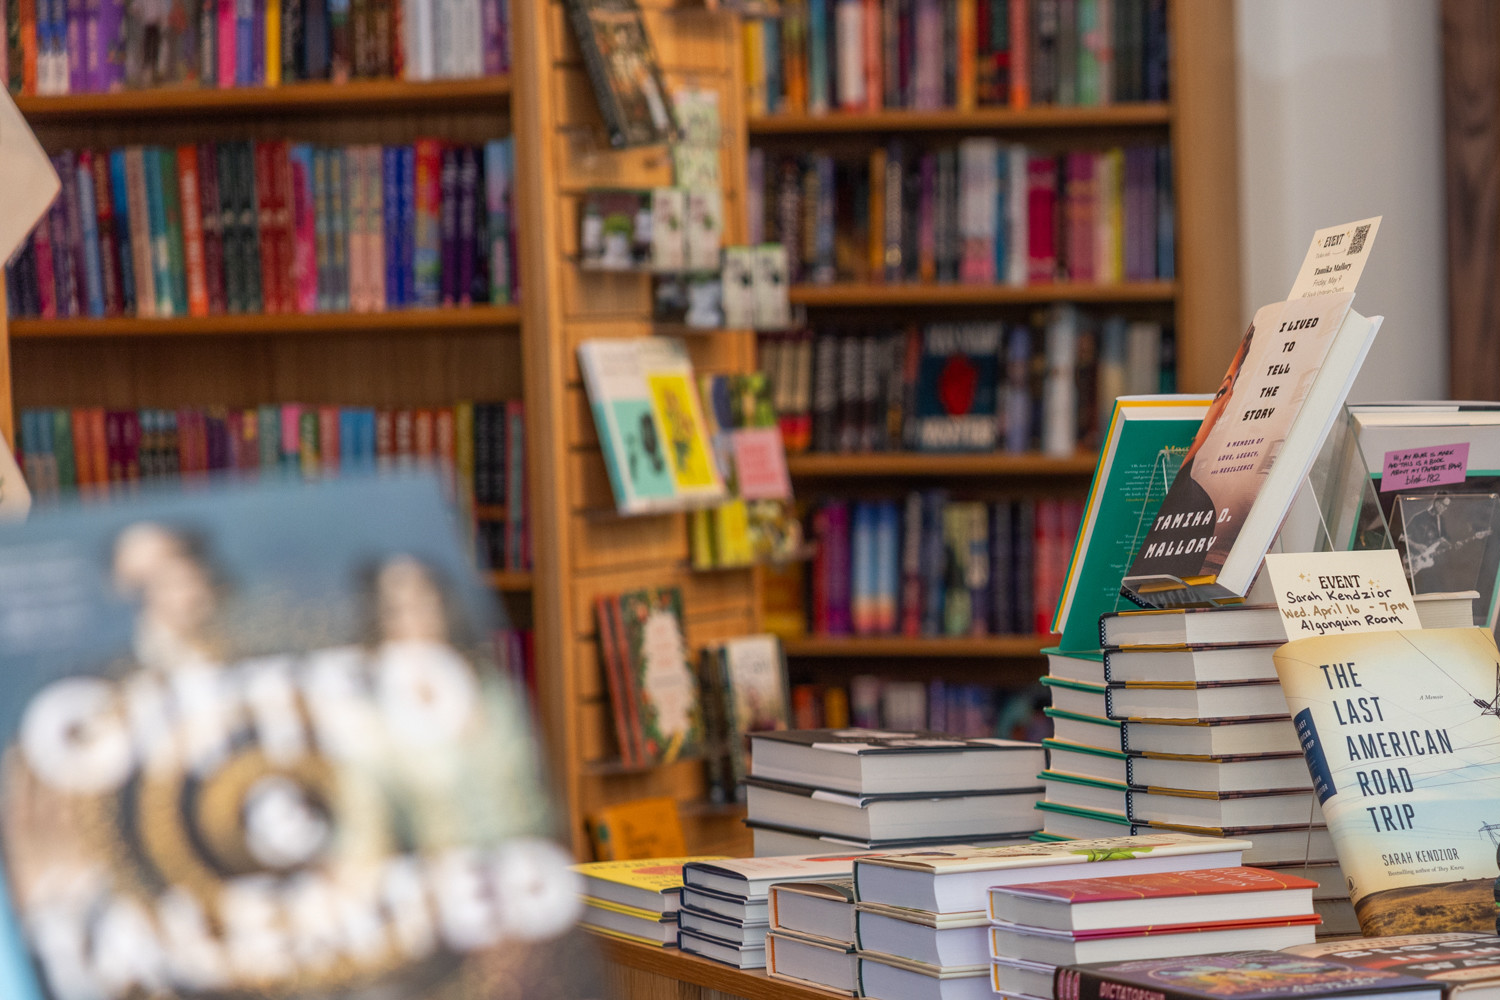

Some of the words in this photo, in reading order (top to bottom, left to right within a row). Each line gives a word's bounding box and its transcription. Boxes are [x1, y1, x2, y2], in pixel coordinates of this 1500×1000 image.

[1324, 233, 1345, 248] EVENT
[1314, 265, 1332, 275] Tamika
[1334, 262, 1352, 271] Mallory
[1279, 322, 1287, 332] I
[1289, 318, 1319, 330] LIVED
[1282, 341, 1295, 353] TO
[1267, 364, 1291, 376] TELL
[1260, 386, 1279, 398] THE
[1242, 408, 1275, 421] STORY
[1154, 508, 1215, 531] TAMIKA
[1217, 508, 1232, 524] D.
[1144, 536, 1217, 559] MALLORY
[1318, 575, 1360, 589] EVENT
[1287, 591, 1322, 603] Sarah
[1326, 588, 1391, 601] Kendzior
[1282, 608, 1310, 619] Wed.
[1313, 603, 1342, 619] April
[1346, 604, 1360, 615] 16
[1379, 602, 1409, 614] 7pm
[1301, 617, 1361, 634] Algonquin
[1365, 615, 1403, 625] Room
[1320, 662, 1362, 690] THE
[1333, 697, 1384, 725] LAST
[1346, 729, 1453, 761] AMERICAN
[1356, 768, 1413, 797] ROAD
[1367, 804, 1415, 832] TRIP
[1382, 853, 1413, 866] SARAH
[1415, 848, 1459, 863] KENDZIOR
